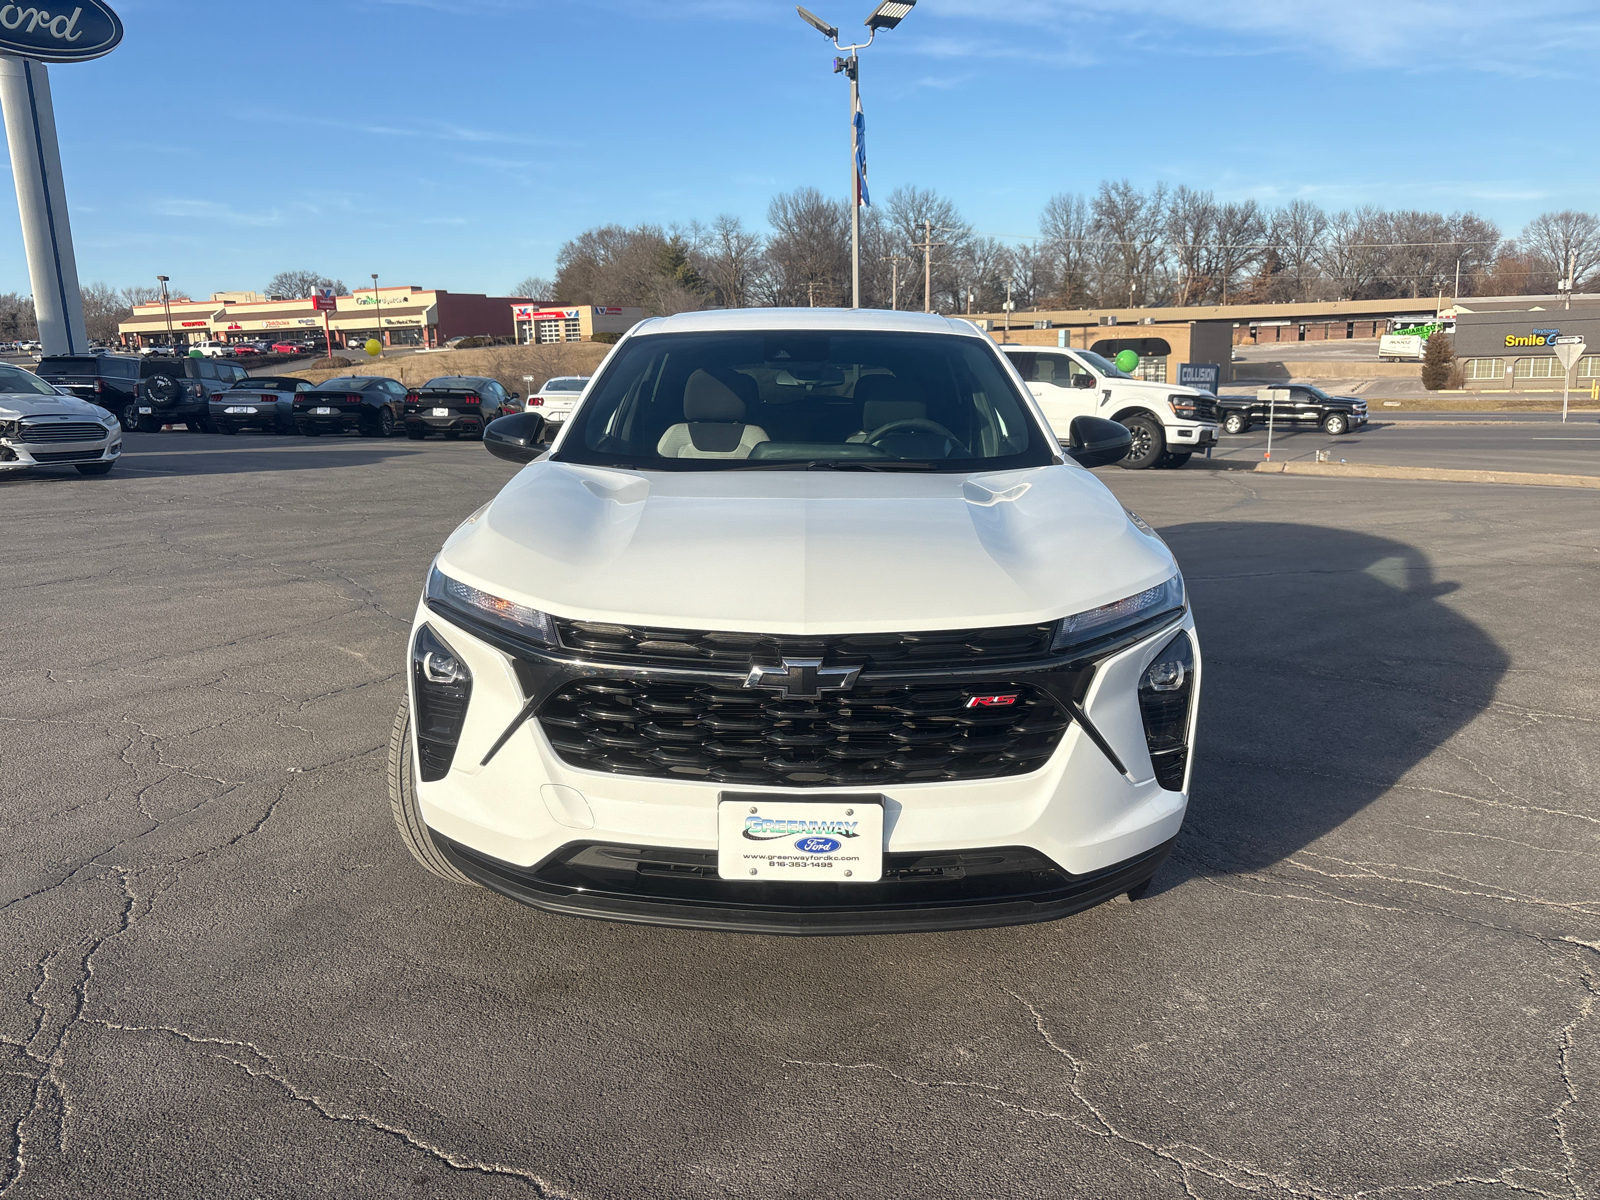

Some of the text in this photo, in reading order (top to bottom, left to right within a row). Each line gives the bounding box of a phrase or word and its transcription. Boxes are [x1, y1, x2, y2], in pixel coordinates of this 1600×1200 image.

[0, 0, 83, 42] ord
[1505, 334, 1546, 347] Smile
[1182, 368, 1216, 381] COLLISION
[968, 694, 1017, 707] RS
[745, 816, 858, 835] GREENWAY
[804, 837, 832, 851] Ford
[743, 854, 860, 862] www.greenwayfordkc.com
